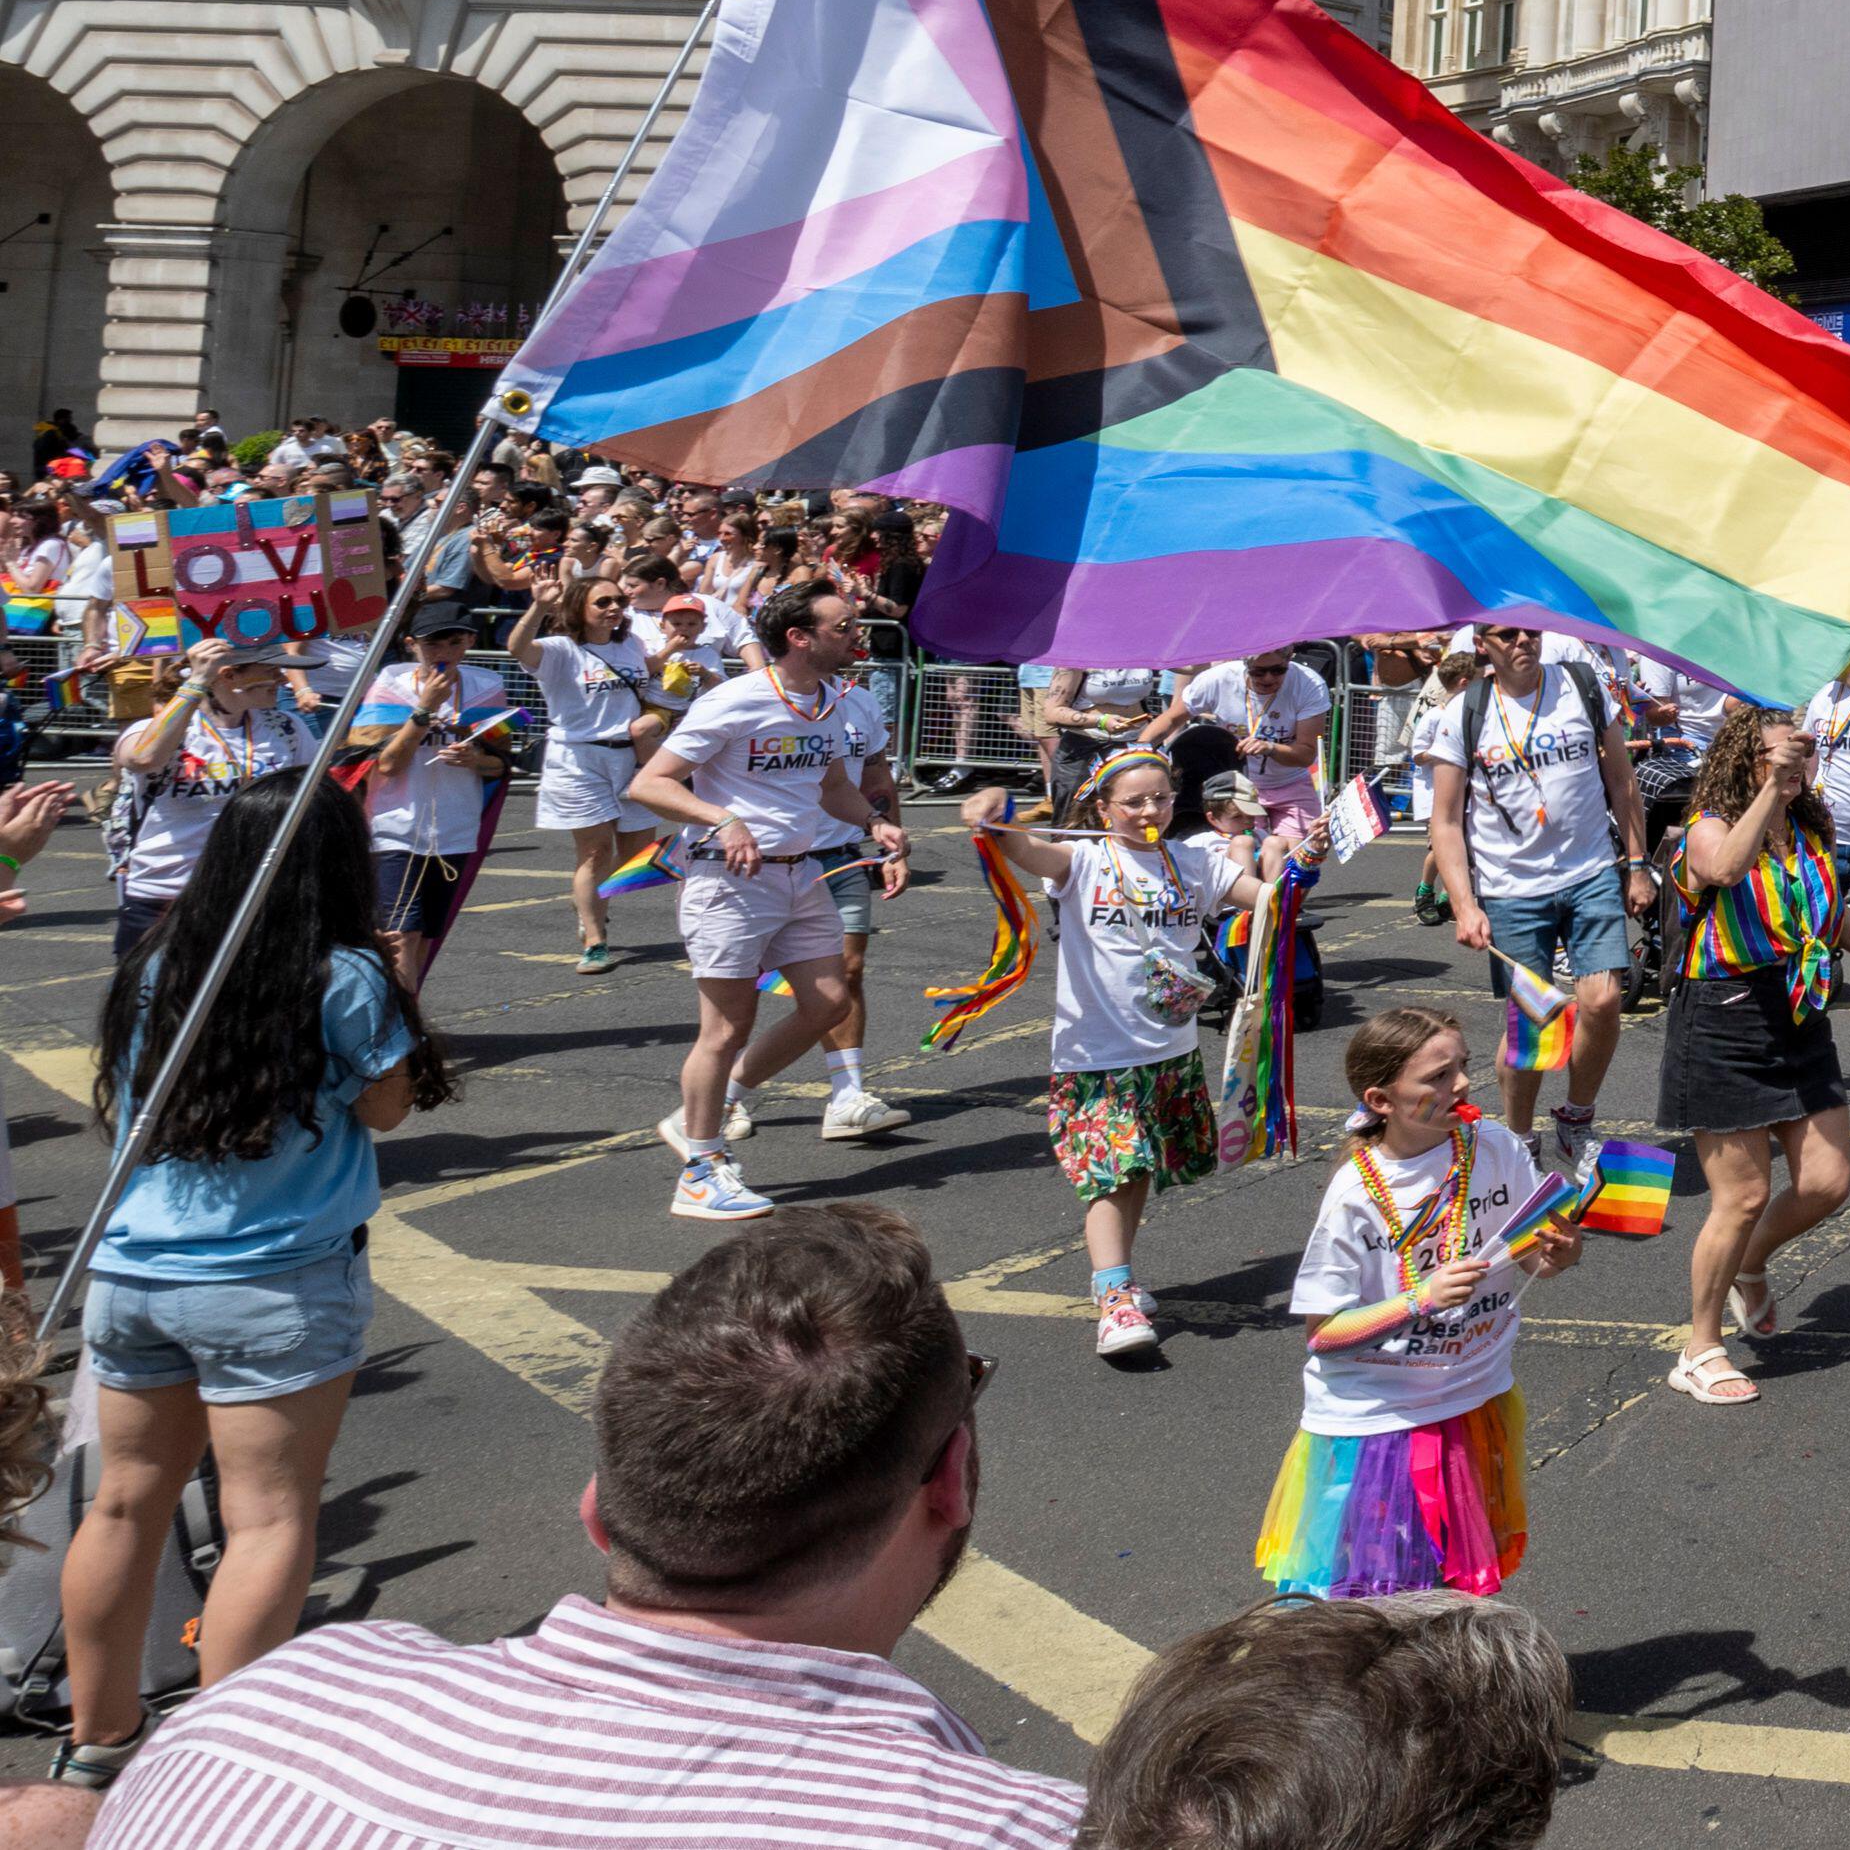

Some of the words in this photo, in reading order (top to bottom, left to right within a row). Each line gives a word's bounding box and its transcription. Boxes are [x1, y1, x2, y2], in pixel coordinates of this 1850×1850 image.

[133, 526, 375, 599] LOVE
[178, 589, 330, 648] YOU
[748, 750, 834, 772] FAMILIE
[1469, 1183, 1511, 1220] Prid
[1404, 1317, 1497, 1356] Rainow
